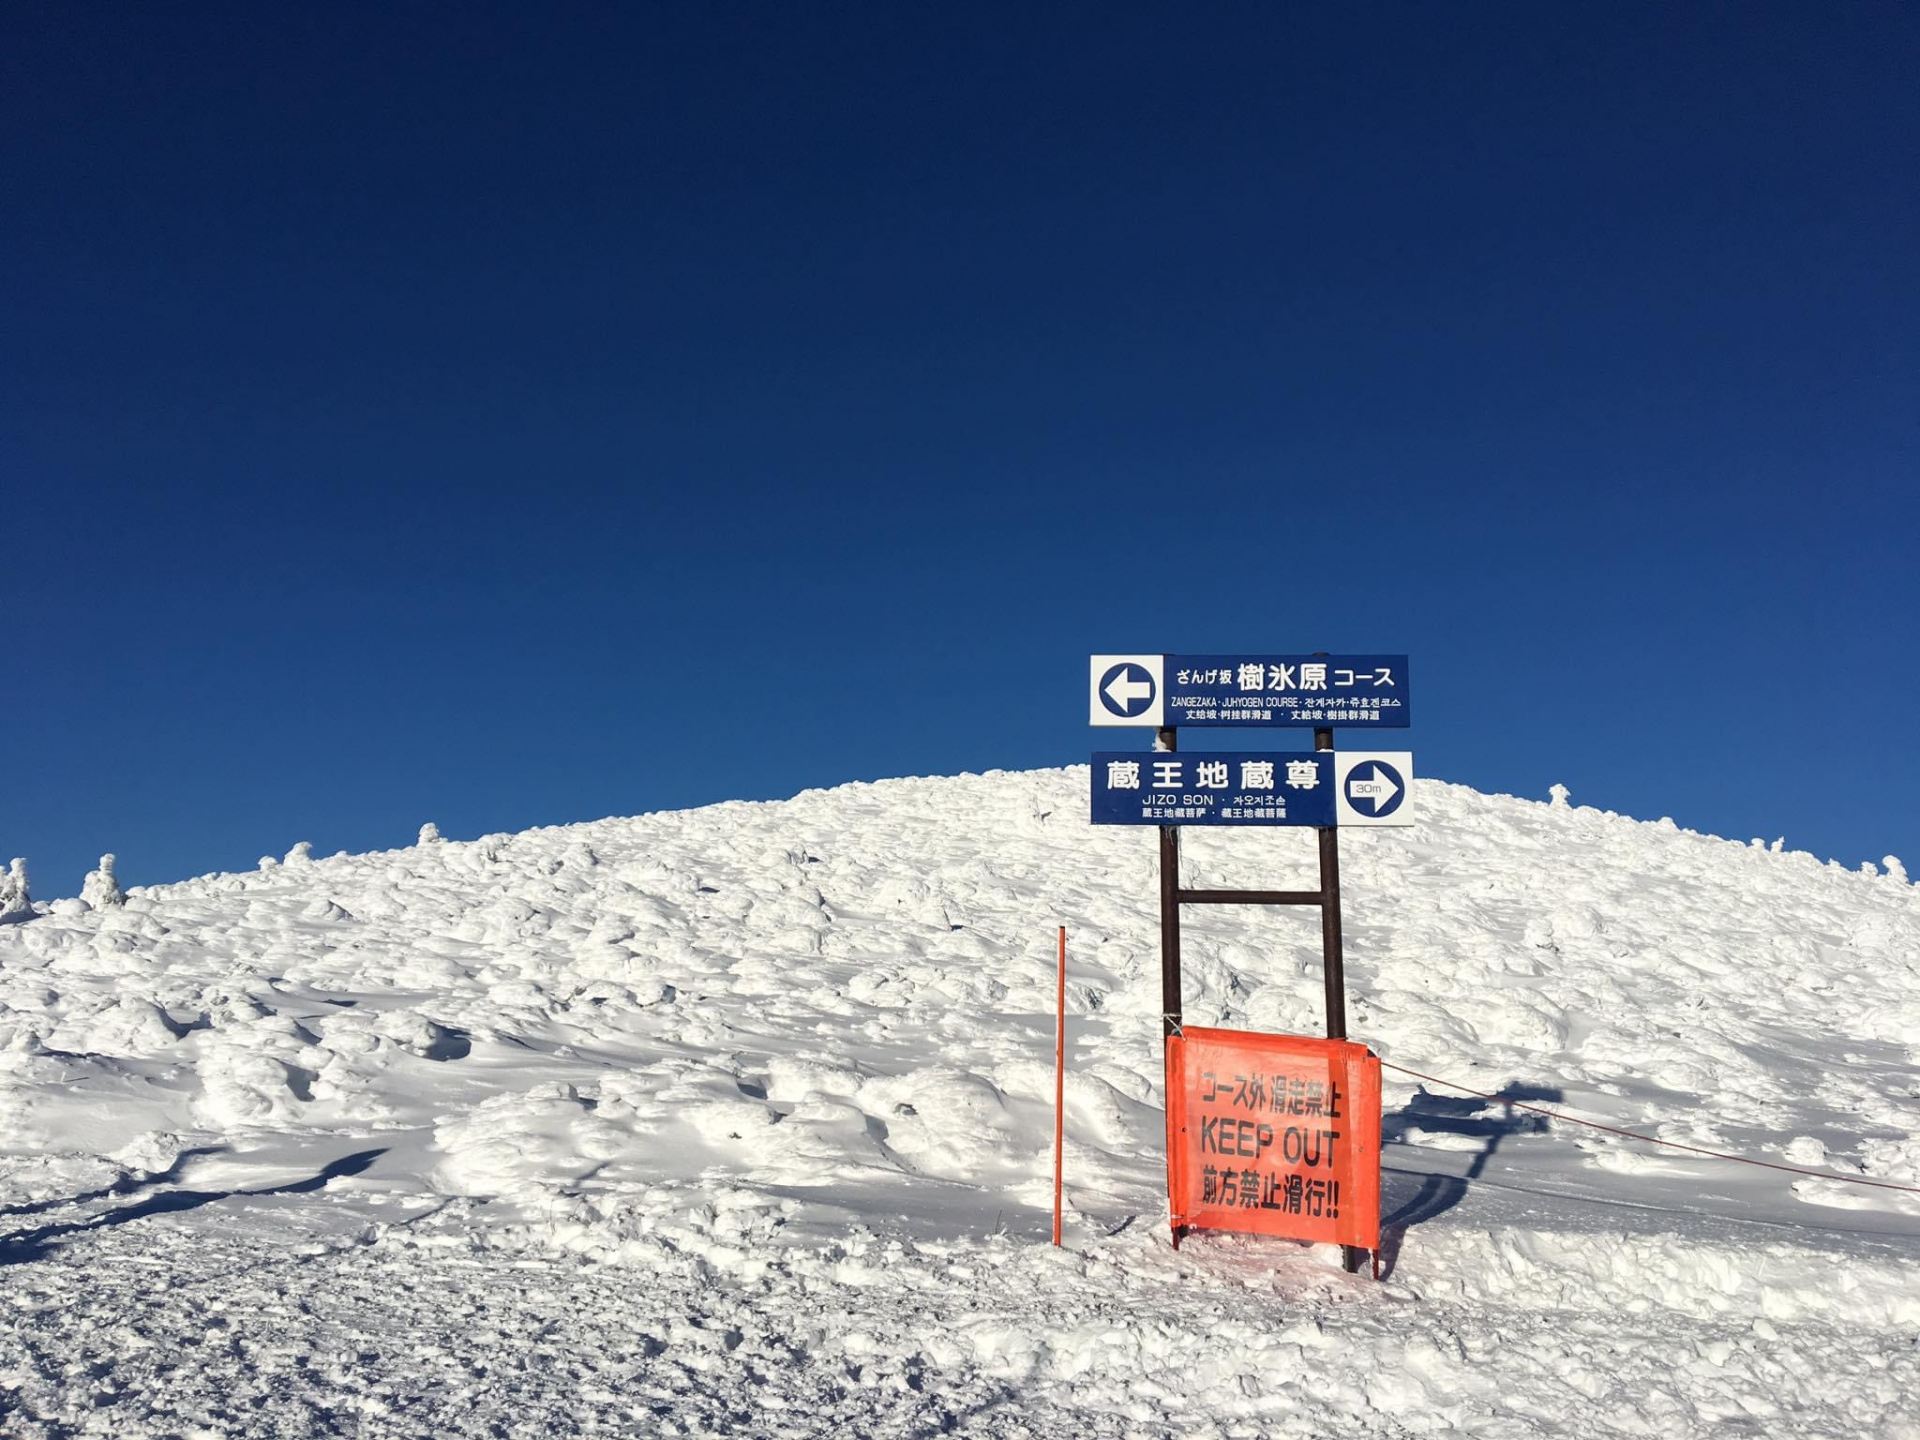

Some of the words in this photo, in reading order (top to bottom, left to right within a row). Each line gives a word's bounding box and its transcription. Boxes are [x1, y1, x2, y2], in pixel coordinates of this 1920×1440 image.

[1237, 663, 1328, 691] 樹氷原
[1334, 667, 1395, 686] コース
[1107, 761, 1320, 790] 蔵王地蔵尊
[1356, 784, 1382, 794] 30m
[1142, 795, 1177, 805] JIZO
[1183, 795, 1213, 805] SON
[1202, 1115, 1273, 1159] KEEP
[1283, 1126, 1340, 1168] OUT
